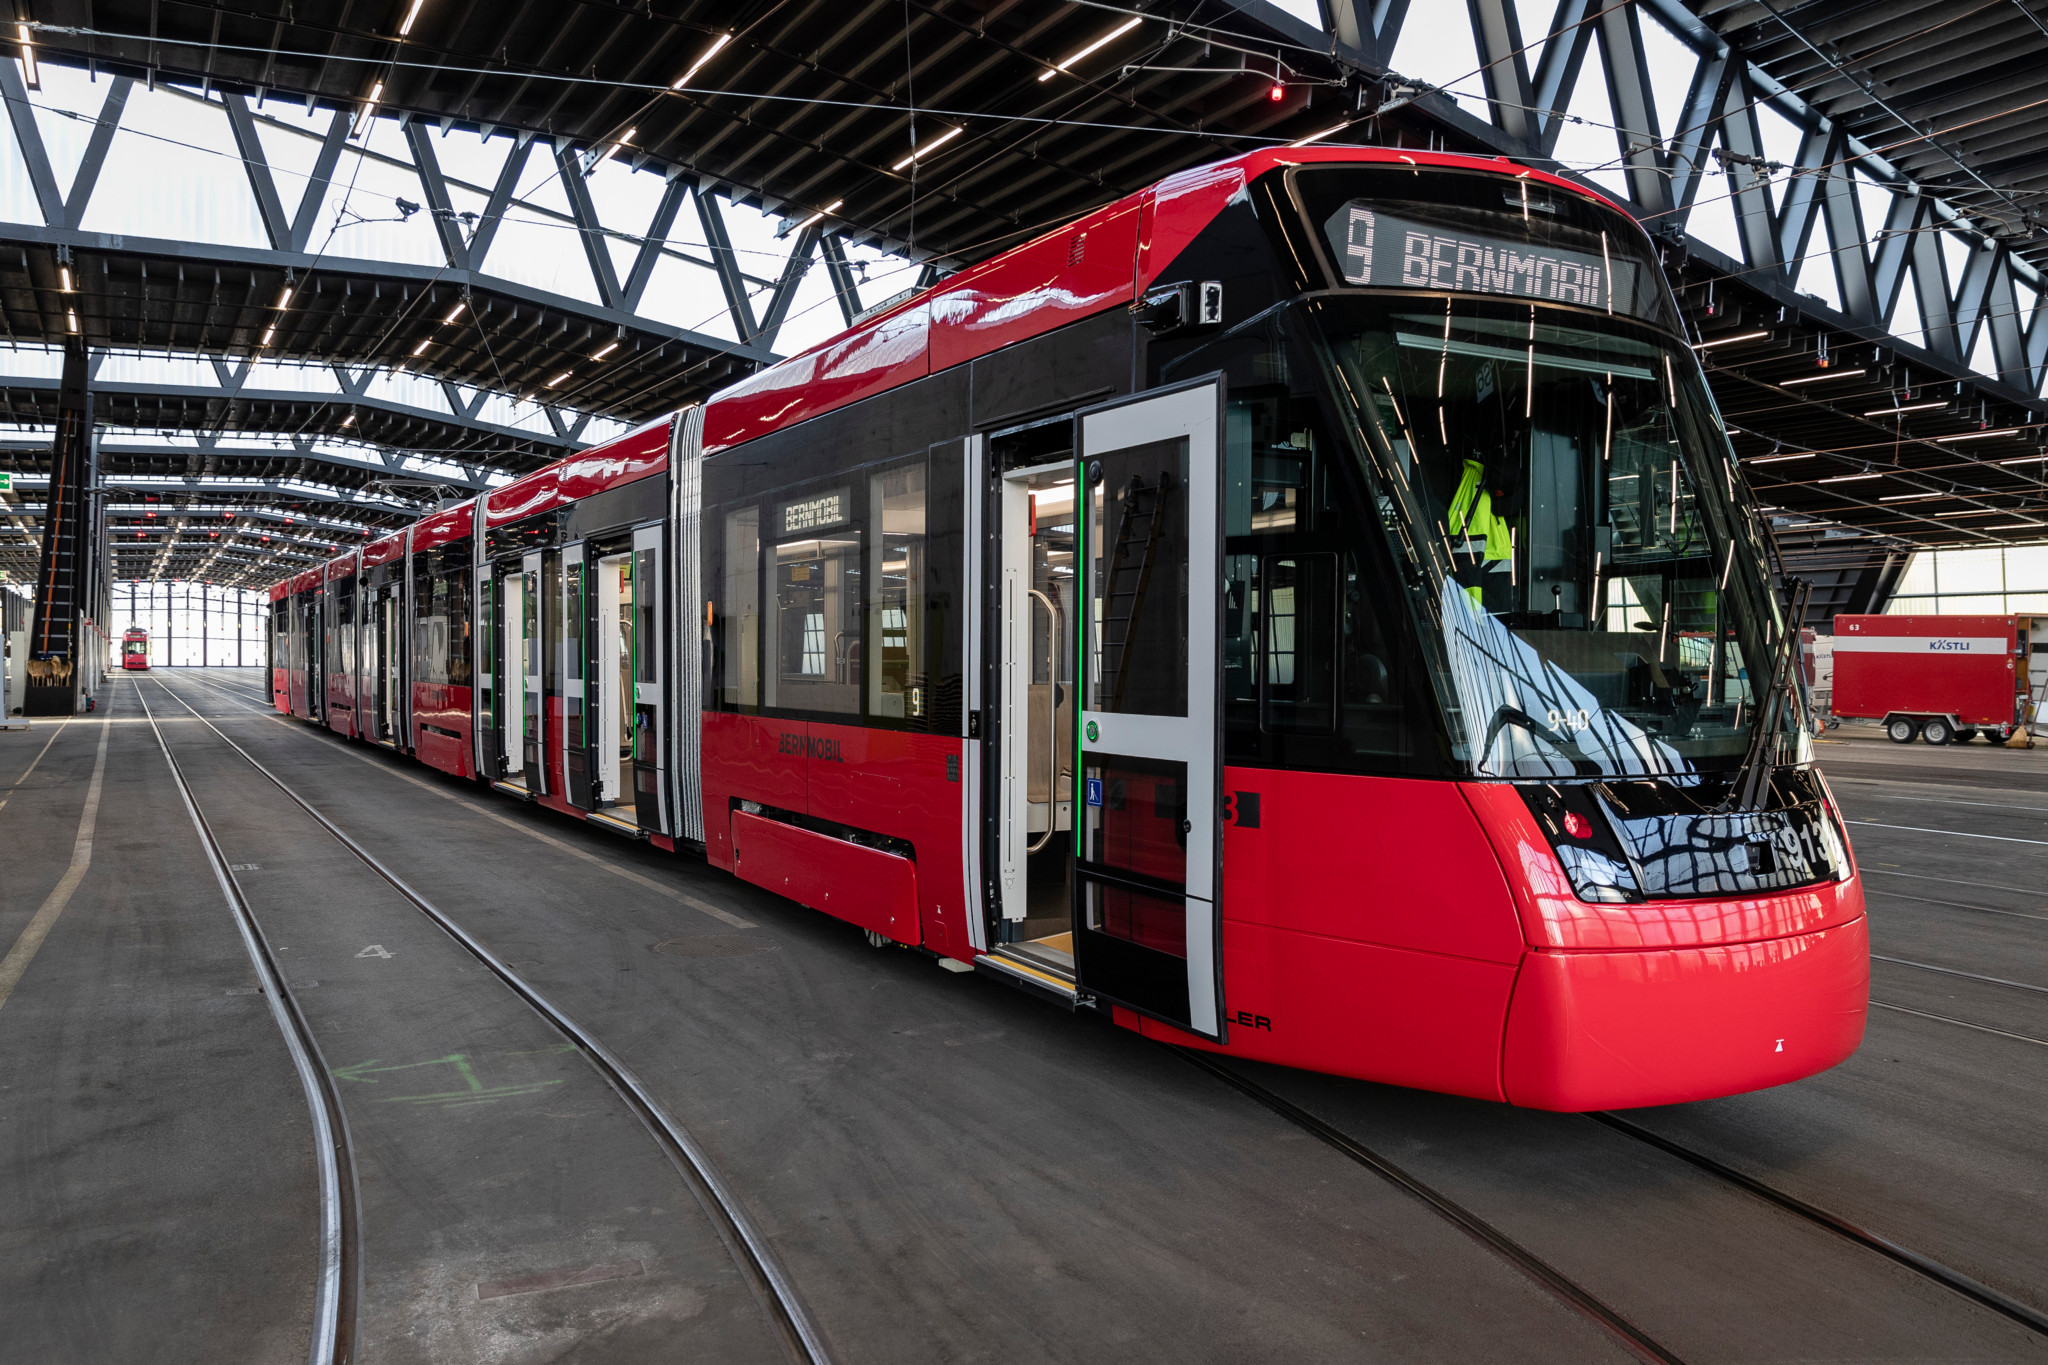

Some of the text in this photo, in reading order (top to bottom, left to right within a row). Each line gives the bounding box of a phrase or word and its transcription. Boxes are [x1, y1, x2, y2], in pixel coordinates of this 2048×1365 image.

[1345, 208, 1375, 285] 9
[785, 495, 843, 532] BERNMOBIL
[1929, 639, 1970, 651] KÄSTLI
[912, 687, 920, 716] 9
[1547, 709, 1589, 731] 9-40
[779, 732, 844, 763] BERNMOBIL
